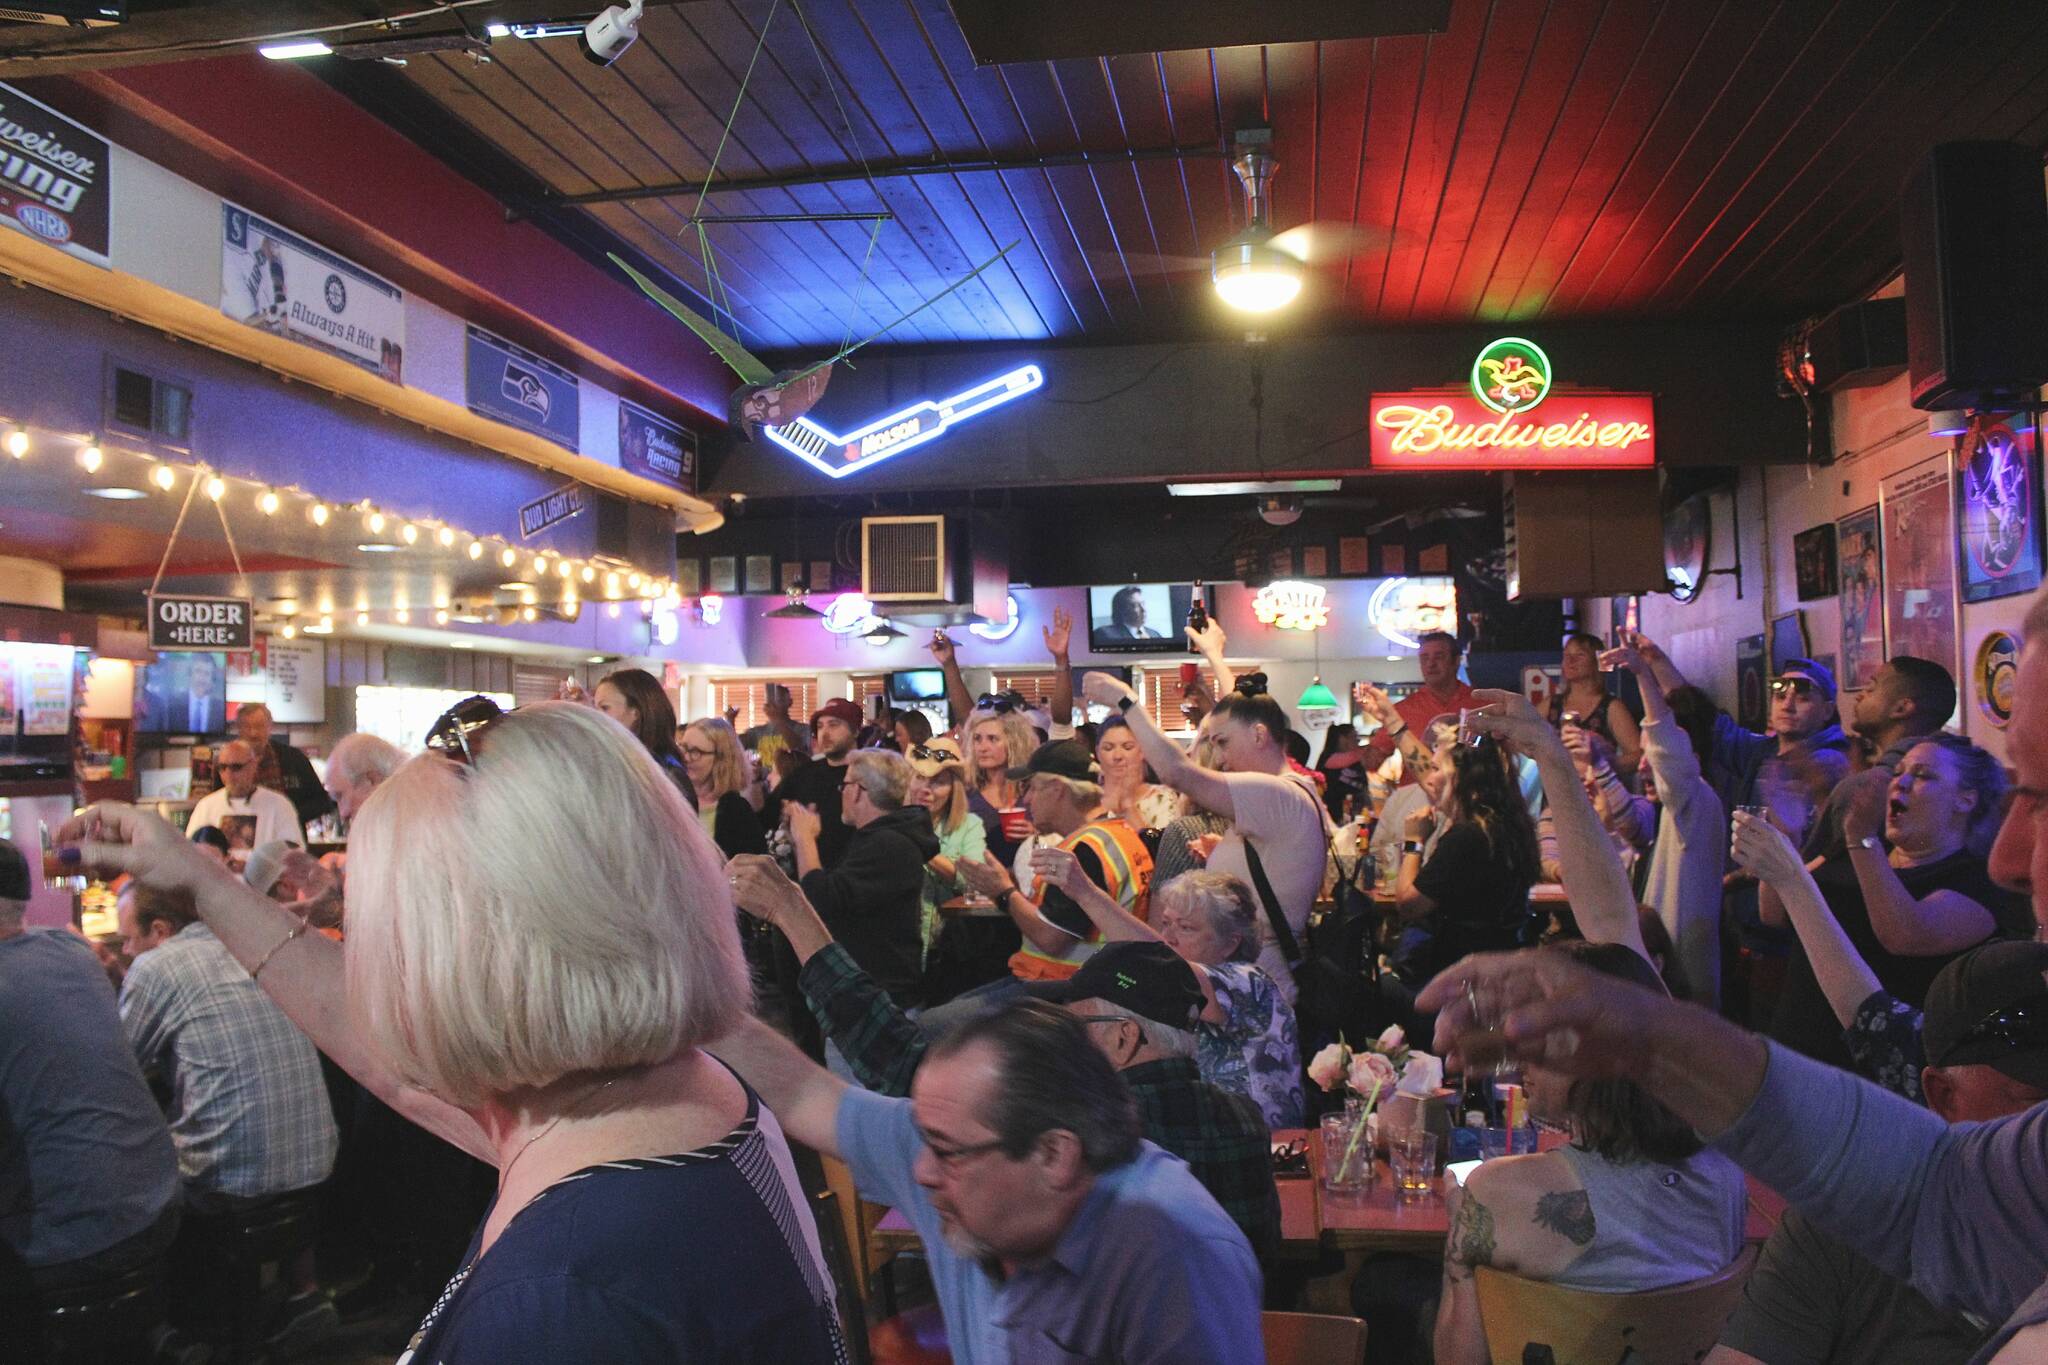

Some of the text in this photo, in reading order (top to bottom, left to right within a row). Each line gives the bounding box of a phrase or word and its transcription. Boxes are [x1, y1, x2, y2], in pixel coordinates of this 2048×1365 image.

[19, 207, 68, 238] NHRA
[290, 301, 344, 337] Always
[344, 324, 356, 344] A
[861, 417, 920, 457] MOLSON
[1375, 404, 1651, 453] Budweiser
[523, 503, 544, 533] BUD
[542, 494, 568, 523] LIGHT
[160, 601, 243, 625] ORDER
[177, 626, 228, 644] HERE
